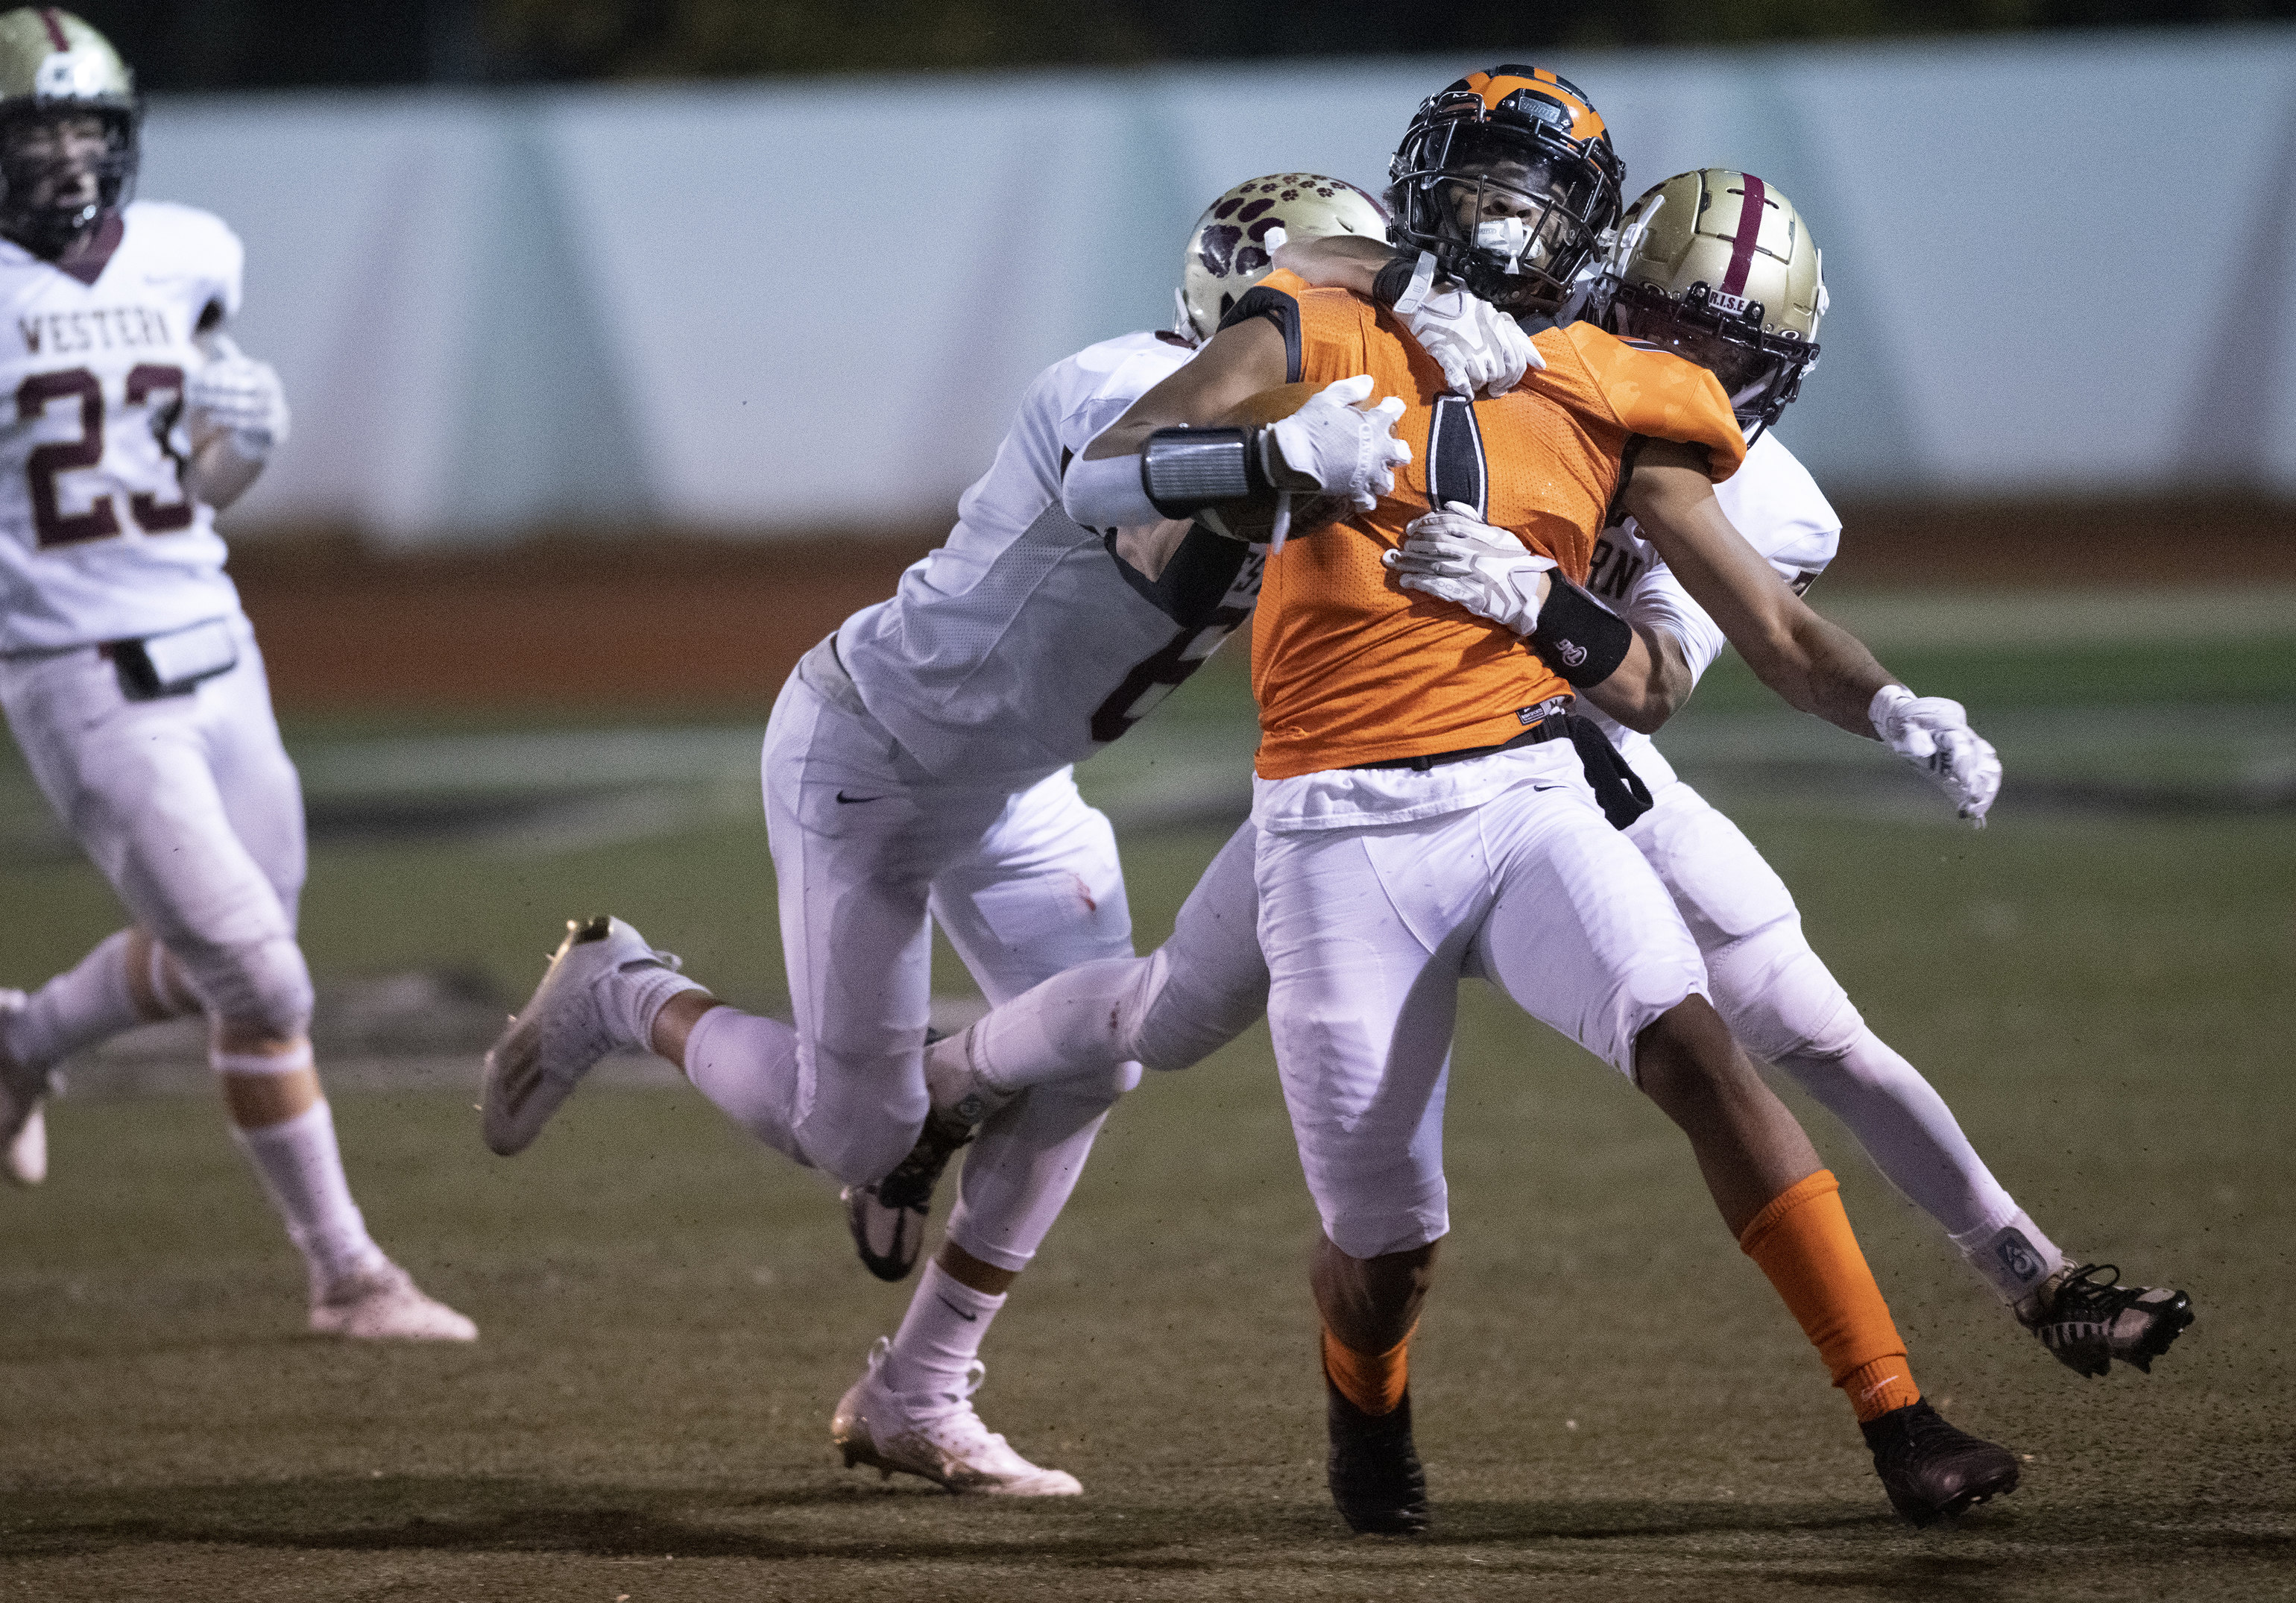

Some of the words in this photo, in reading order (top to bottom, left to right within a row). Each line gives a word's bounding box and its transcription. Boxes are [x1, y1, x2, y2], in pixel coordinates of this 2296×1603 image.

[1709, 291, 1745, 312] R.I.S.E
[16, 362, 194, 550] 23
[1425, 391, 1489, 524] 1
